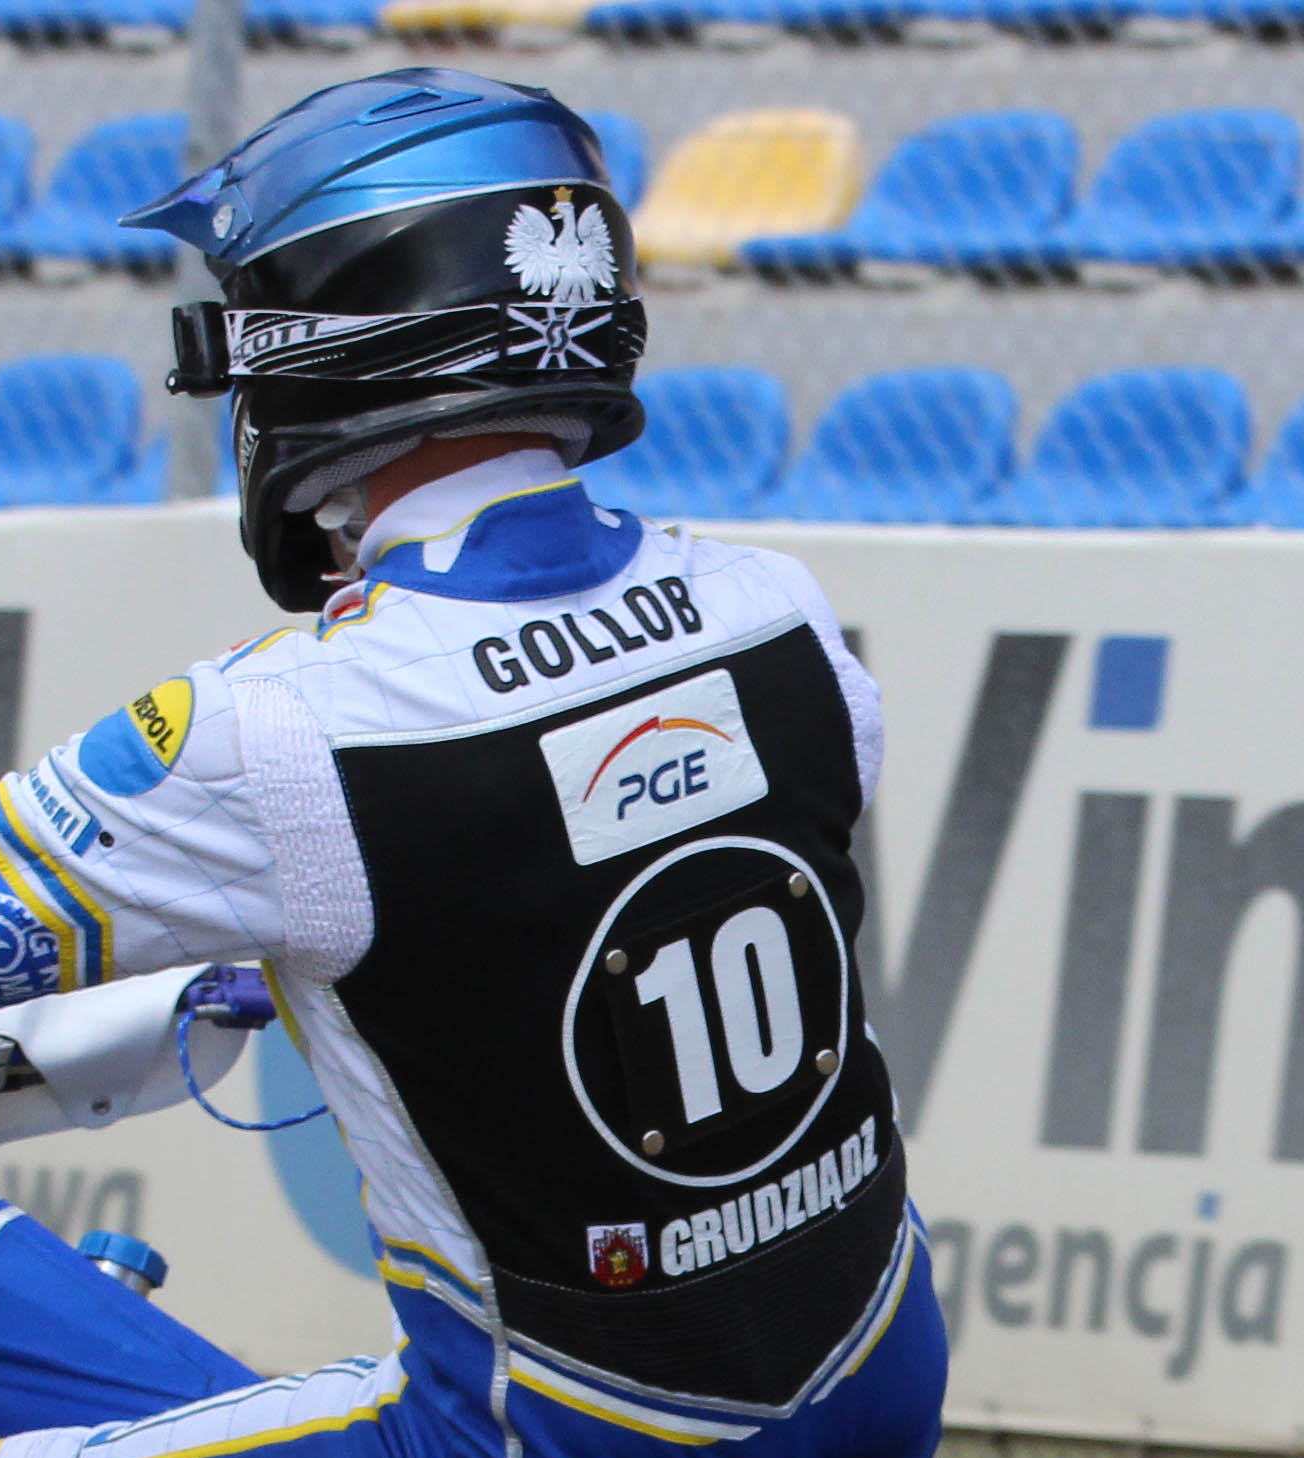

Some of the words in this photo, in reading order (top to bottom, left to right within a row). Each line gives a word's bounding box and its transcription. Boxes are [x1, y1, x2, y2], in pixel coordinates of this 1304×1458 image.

[472, 576, 703, 693] GOLLOB
[617, 749, 709, 820] PGE
[635, 906, 804, 1124] 10
[660, 1115, 879, 1277] GRUDZIĄDZ
[926, 1192, 1289, 1382] gencja
